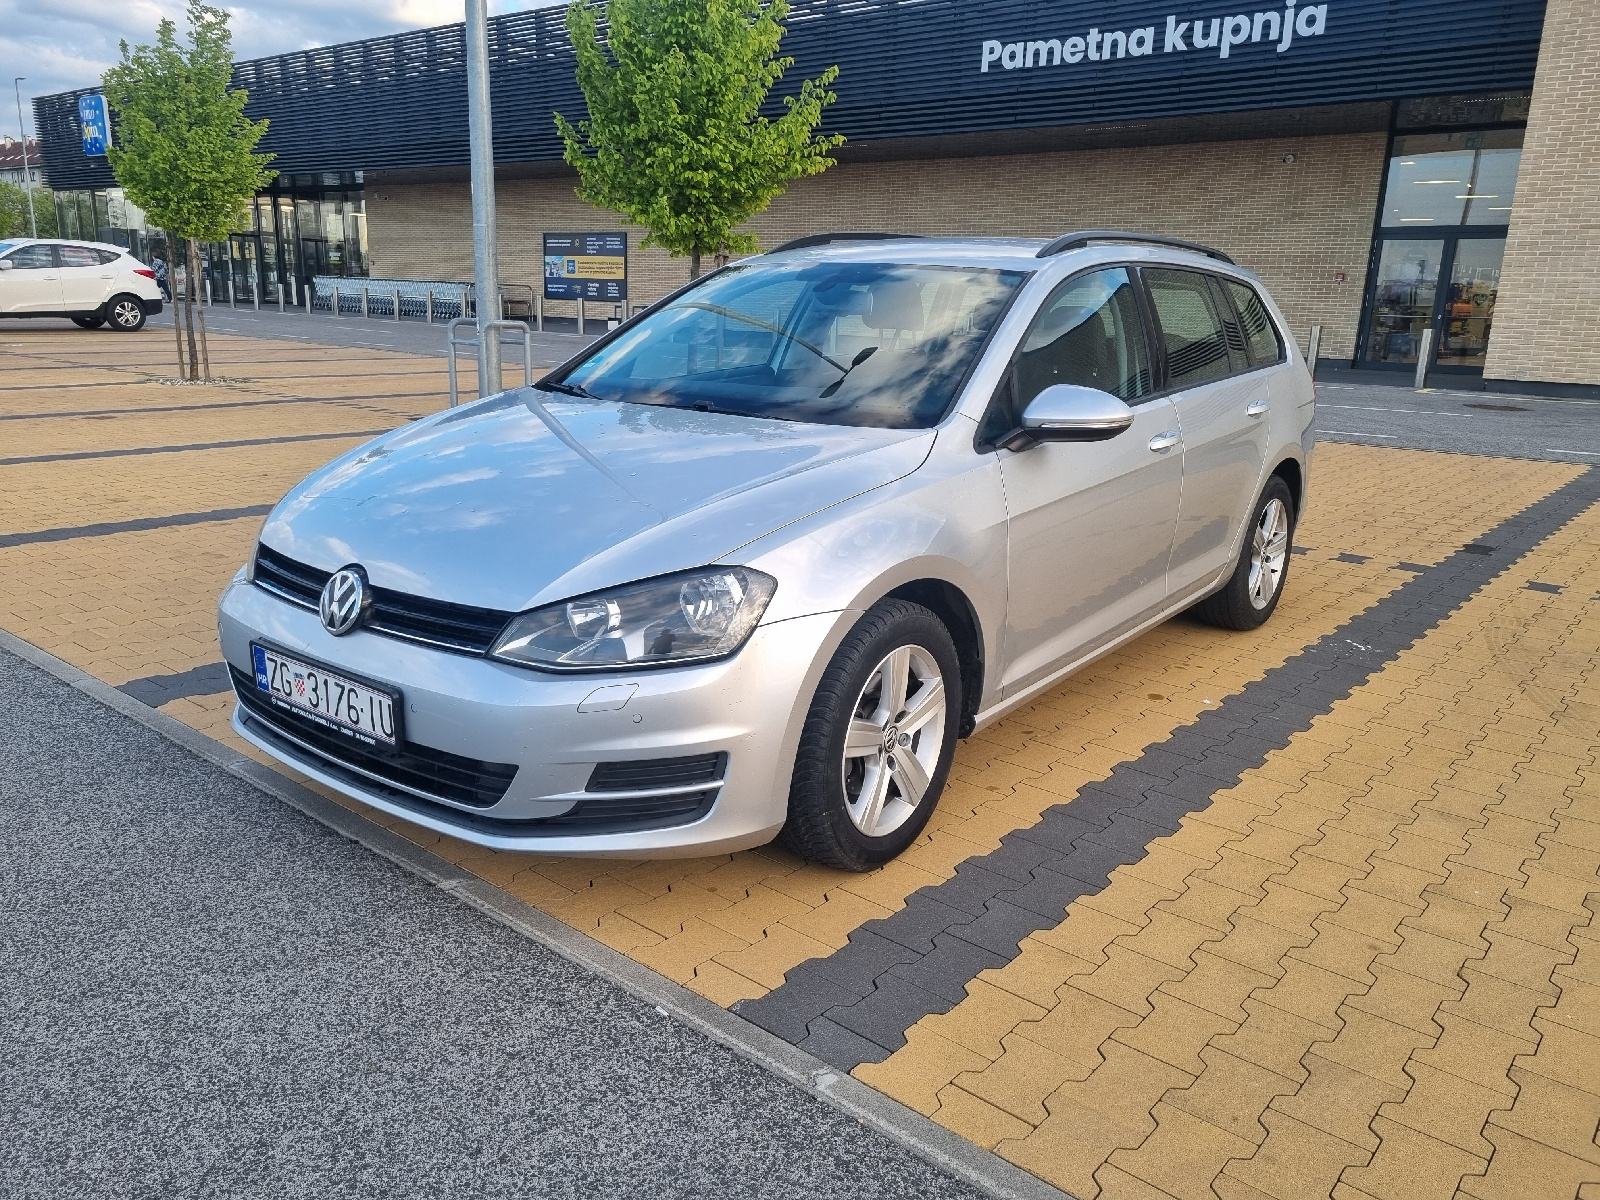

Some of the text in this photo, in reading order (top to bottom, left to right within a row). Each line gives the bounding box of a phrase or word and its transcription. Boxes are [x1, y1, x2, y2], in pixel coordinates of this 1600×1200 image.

[981, 0, 1328, 73] Pametna kupnja
[266, 658, 293, 697] ZG
